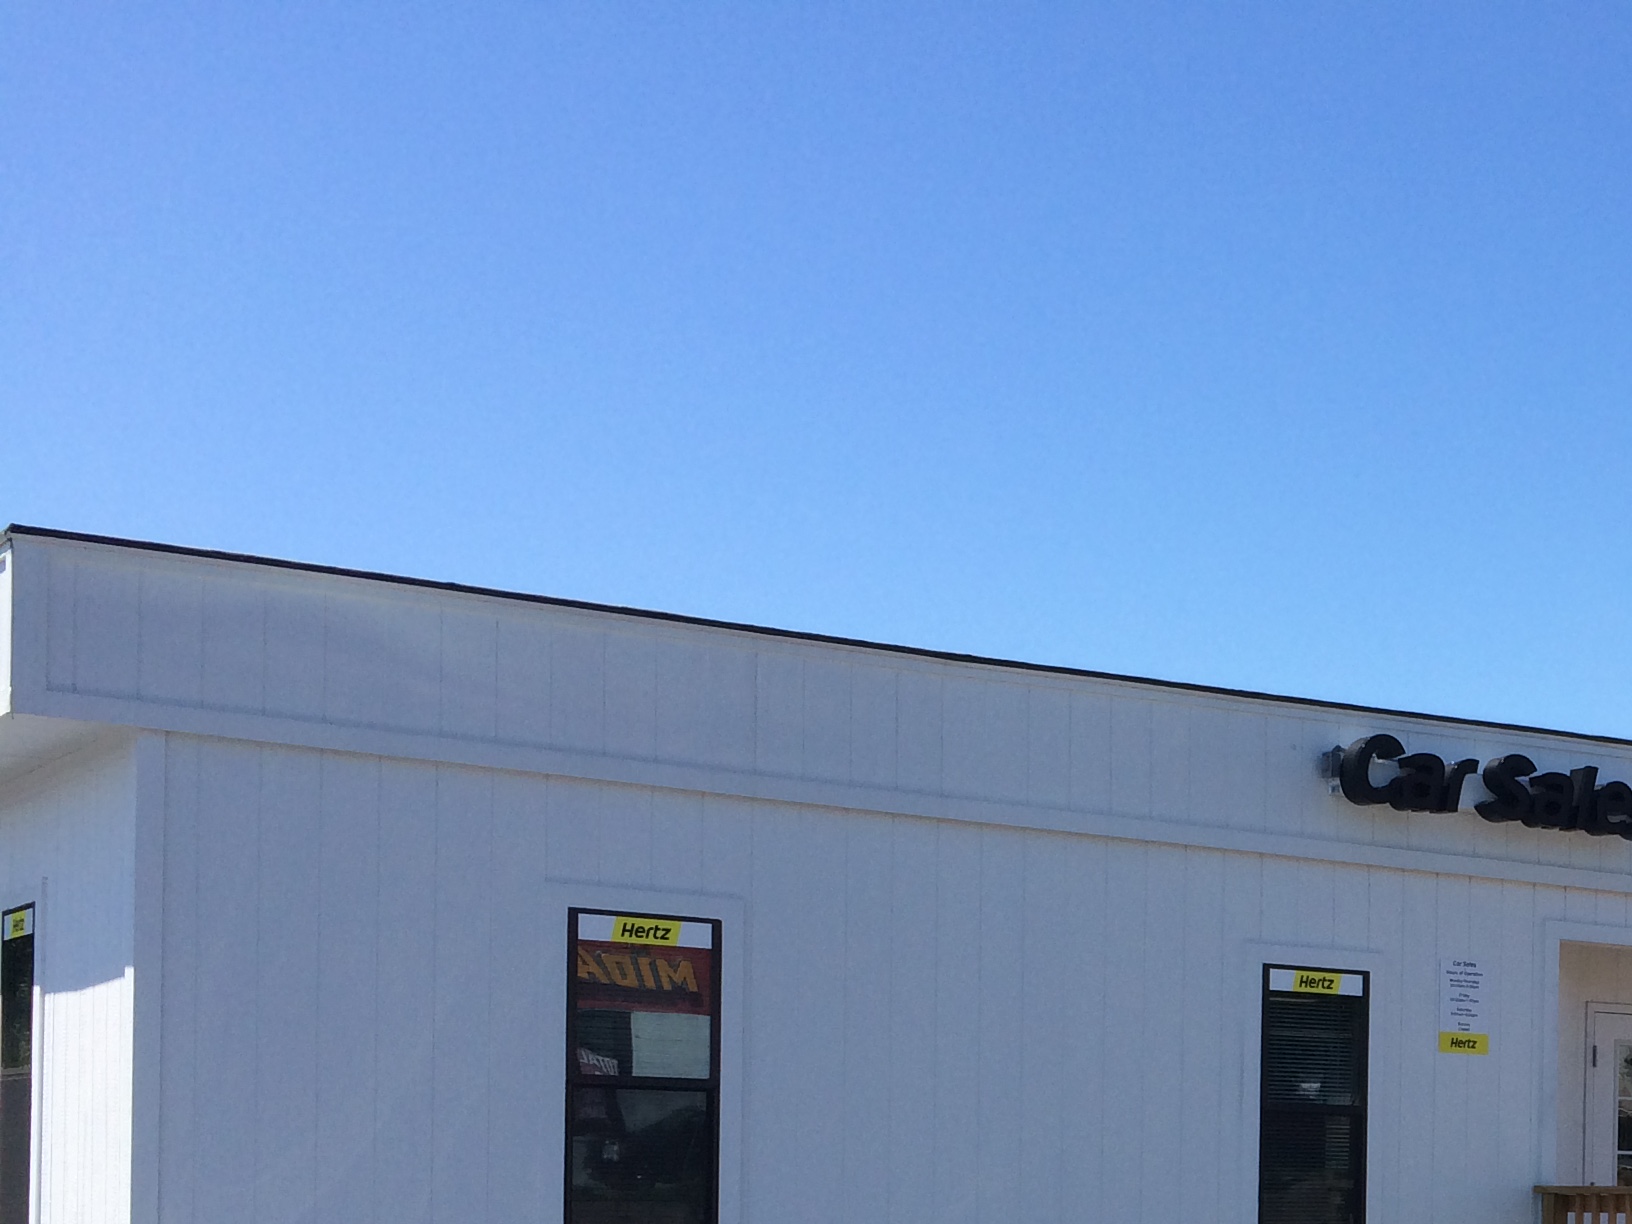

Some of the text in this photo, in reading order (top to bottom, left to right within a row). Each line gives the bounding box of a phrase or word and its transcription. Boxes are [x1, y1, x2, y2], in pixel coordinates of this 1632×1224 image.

[1339, 733, 1479, 814] Car
[620, 921, 673, 941] Hertz
[1299, 974, 1335, 990] Hertz
[1450, 1037, 1478, 1050] Hertz
